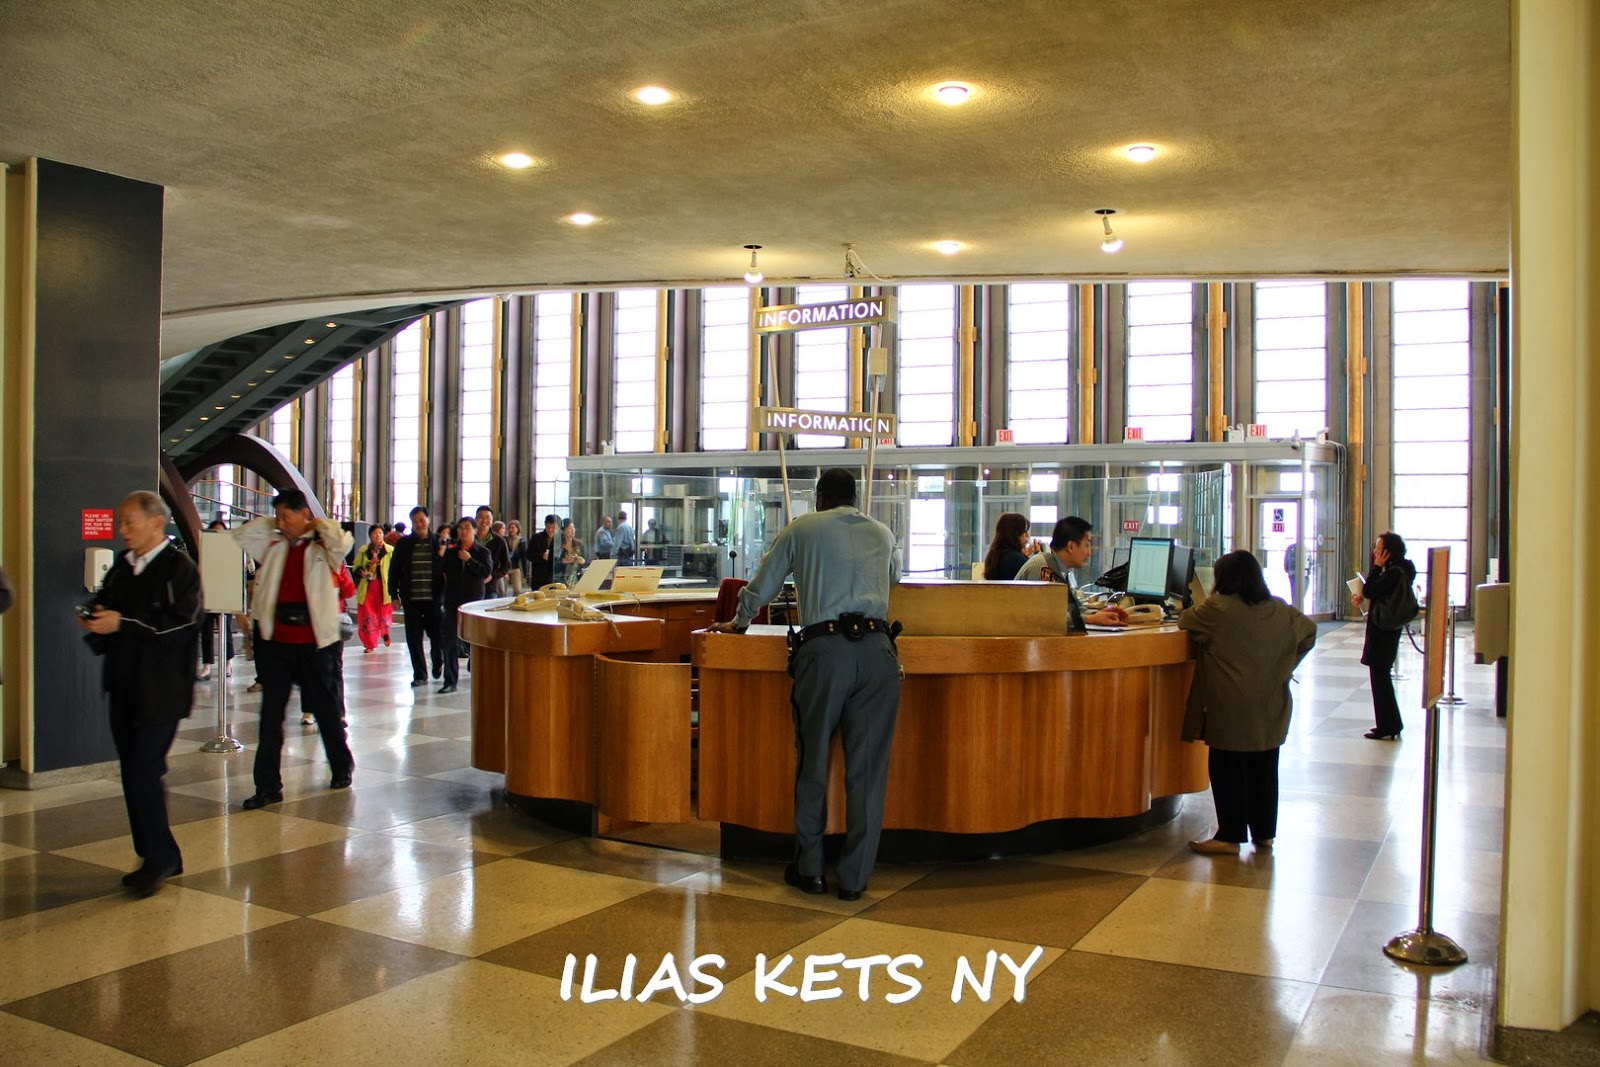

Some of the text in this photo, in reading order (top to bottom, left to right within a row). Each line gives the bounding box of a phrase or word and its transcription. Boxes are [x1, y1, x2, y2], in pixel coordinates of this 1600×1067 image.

[758, 301, 883, 327] INFORMATION
[767, 412, 890, 433] INFORMATION
[1000, 430, 1013, 442] EXIT
[1128, 427, 1142, 439] EXIT
[1250, 425, 1266, 437] EXIT
[1123, 522, 1139, 530] EXIT
